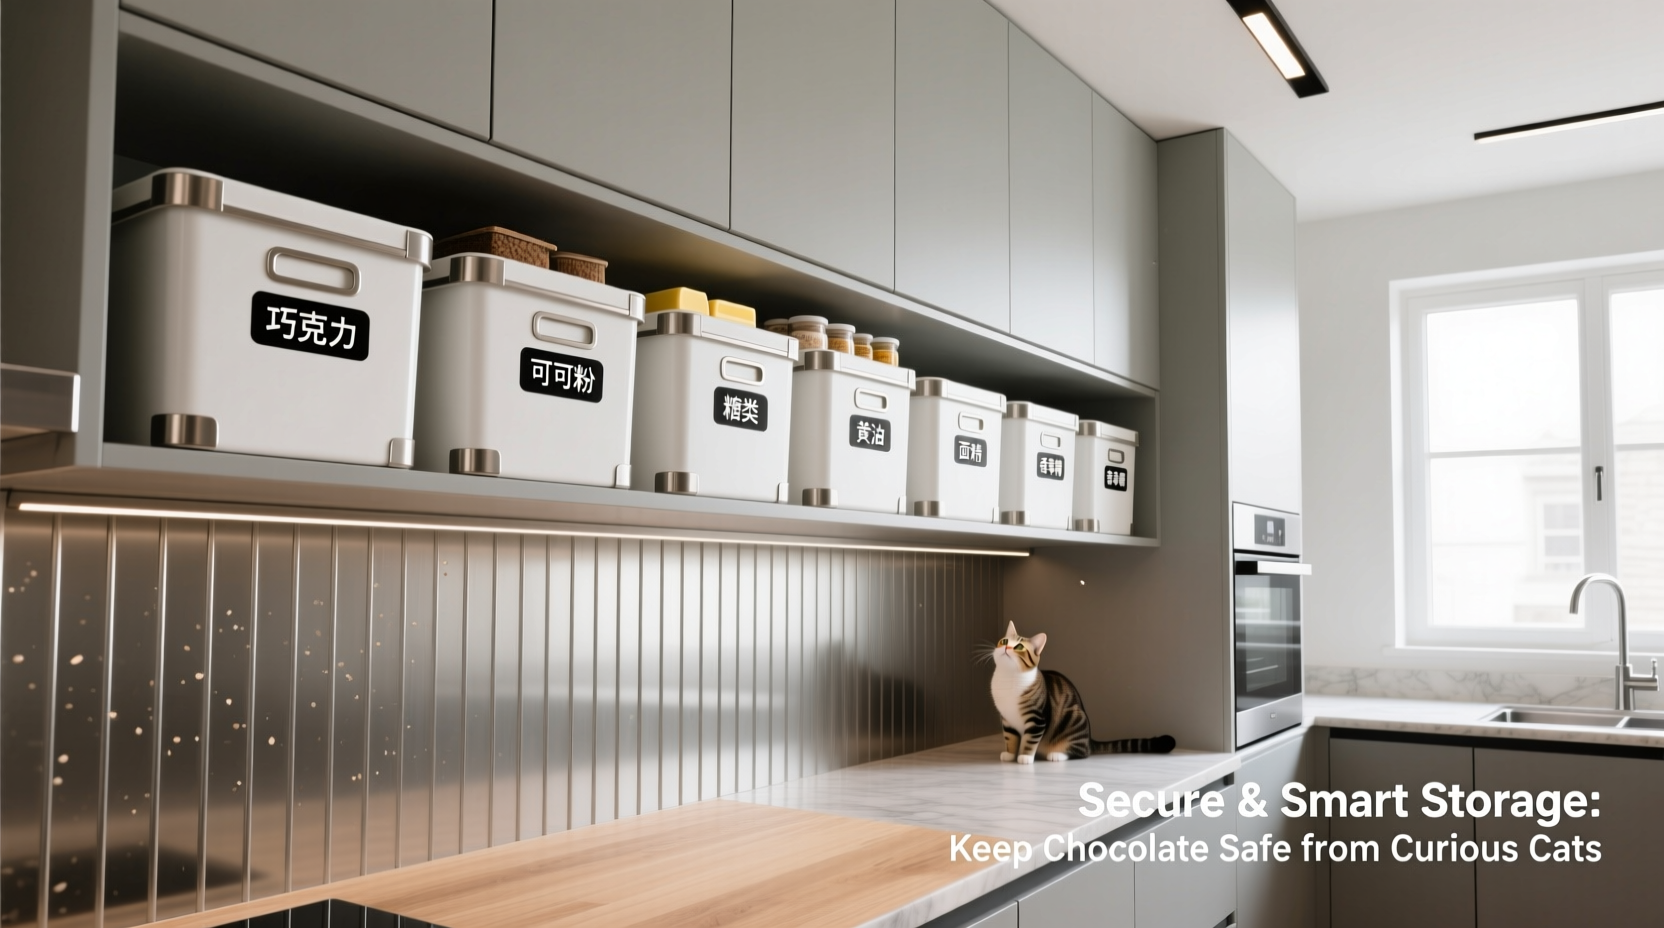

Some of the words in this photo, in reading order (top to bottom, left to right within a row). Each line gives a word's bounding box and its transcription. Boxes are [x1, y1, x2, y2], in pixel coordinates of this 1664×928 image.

[265, 299, 357, 350] 巧克力
[530, 357, 596, 394] 可可粉
